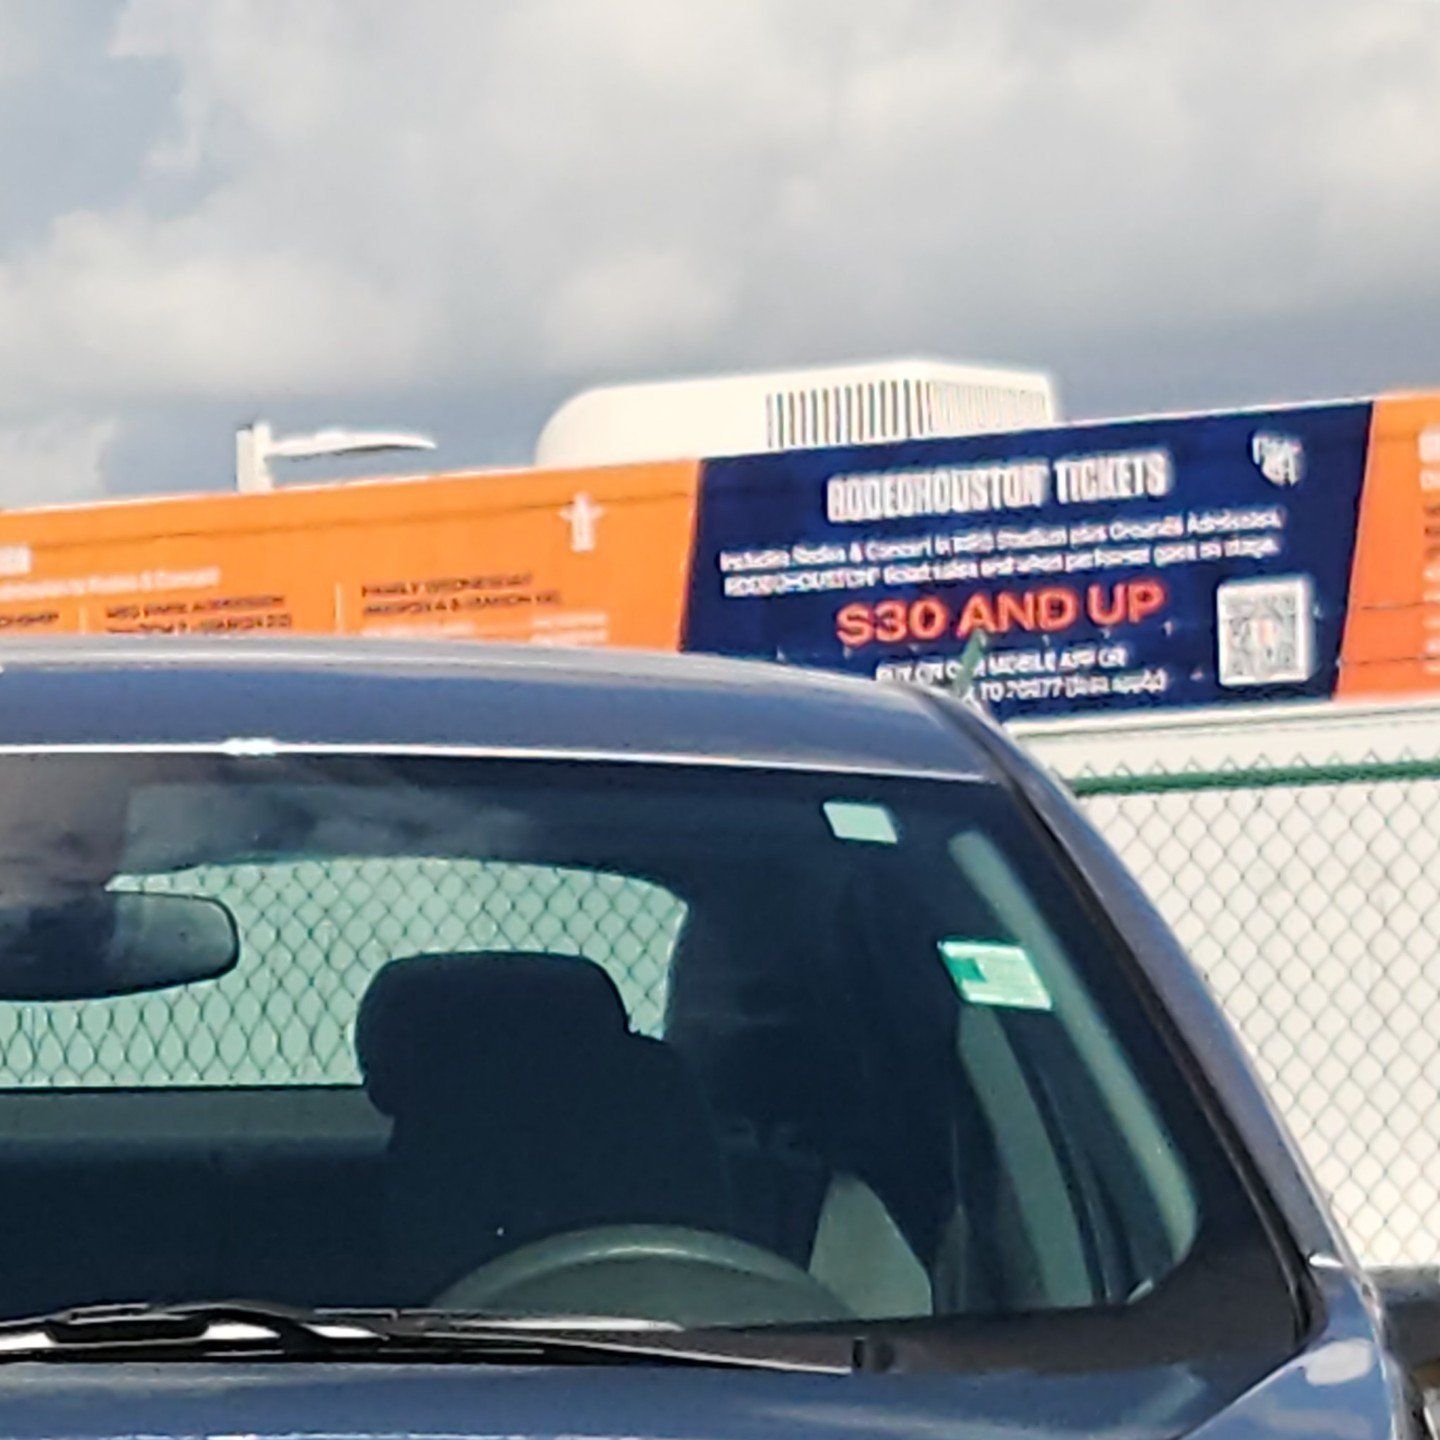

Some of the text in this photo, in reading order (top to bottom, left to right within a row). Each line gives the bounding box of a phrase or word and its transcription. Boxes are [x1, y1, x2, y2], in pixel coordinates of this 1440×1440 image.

[1053, 451, 1169, 504] TICKETS
[956, 588, 1079, 639] AND
[1088, 580, 1165, 626] UP
